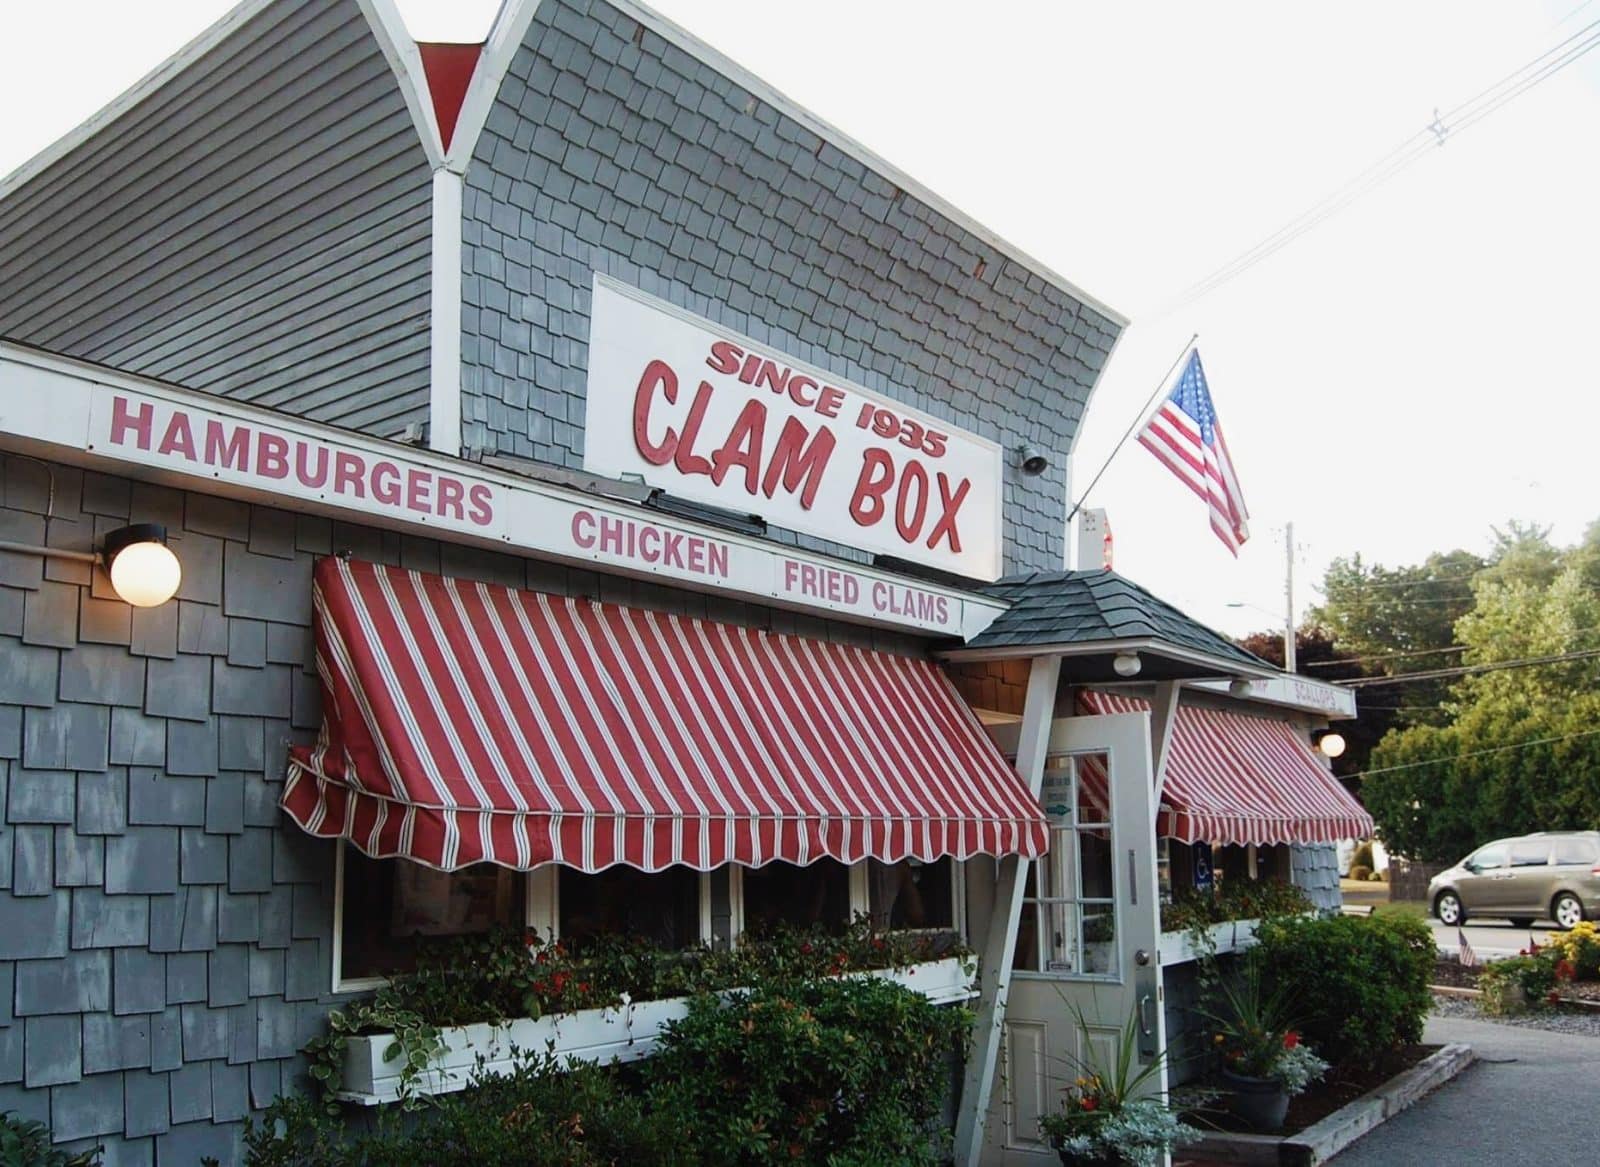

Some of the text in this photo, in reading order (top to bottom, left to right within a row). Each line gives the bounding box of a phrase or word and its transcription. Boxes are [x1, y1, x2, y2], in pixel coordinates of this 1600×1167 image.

[632, 359, 972, 554] CLAM BOX
[705, 341, 949, 459] SINCE 1935
[109, 396, 495, 526] HAMBURGERS
[571, 510, 729, 578] CHICKEN
[784, 561, 950, 625] FRIED CLAMS
